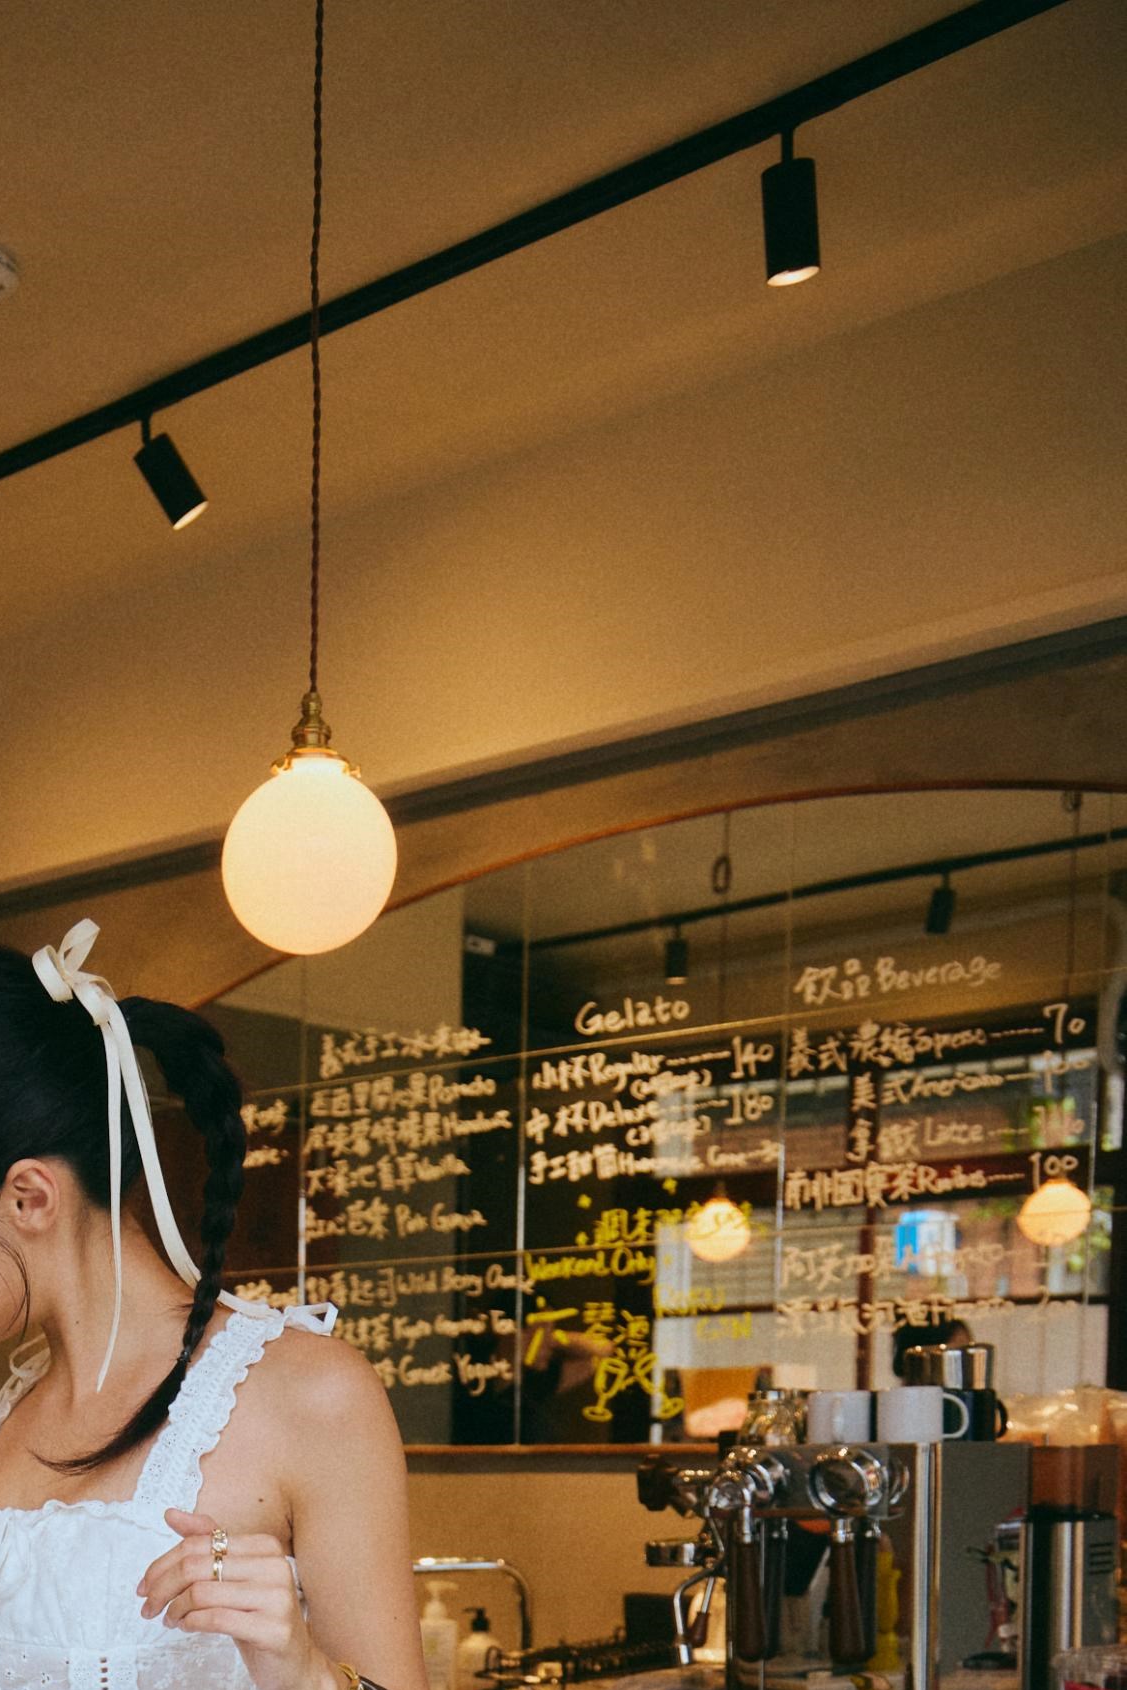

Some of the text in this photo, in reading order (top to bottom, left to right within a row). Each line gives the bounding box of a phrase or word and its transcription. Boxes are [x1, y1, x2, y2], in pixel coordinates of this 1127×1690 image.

[794, 956, 1002, 1004] 飲品 Beverage
[575, 996, 690, 1036] Gelato
[1044, 1003, 1086, 1044] 70
[588, 1051, 665, 1093] Regular
[730, 1036, 774, 1078] 140
[908, 1071, 1005, 1099] Americano
[526, 1101, 588, 1145] 中杯
[587, 1101, 661, 1134] Deluxe
[725, 1088, 774, 1125] 180
[924, 1116, 985, 1146] Latte
[1030, 1152, 1078, 1190] 100
[524, 1247, 658, 1285] Weekend Only
[454, 1353, 515, 1396] Yogurt
